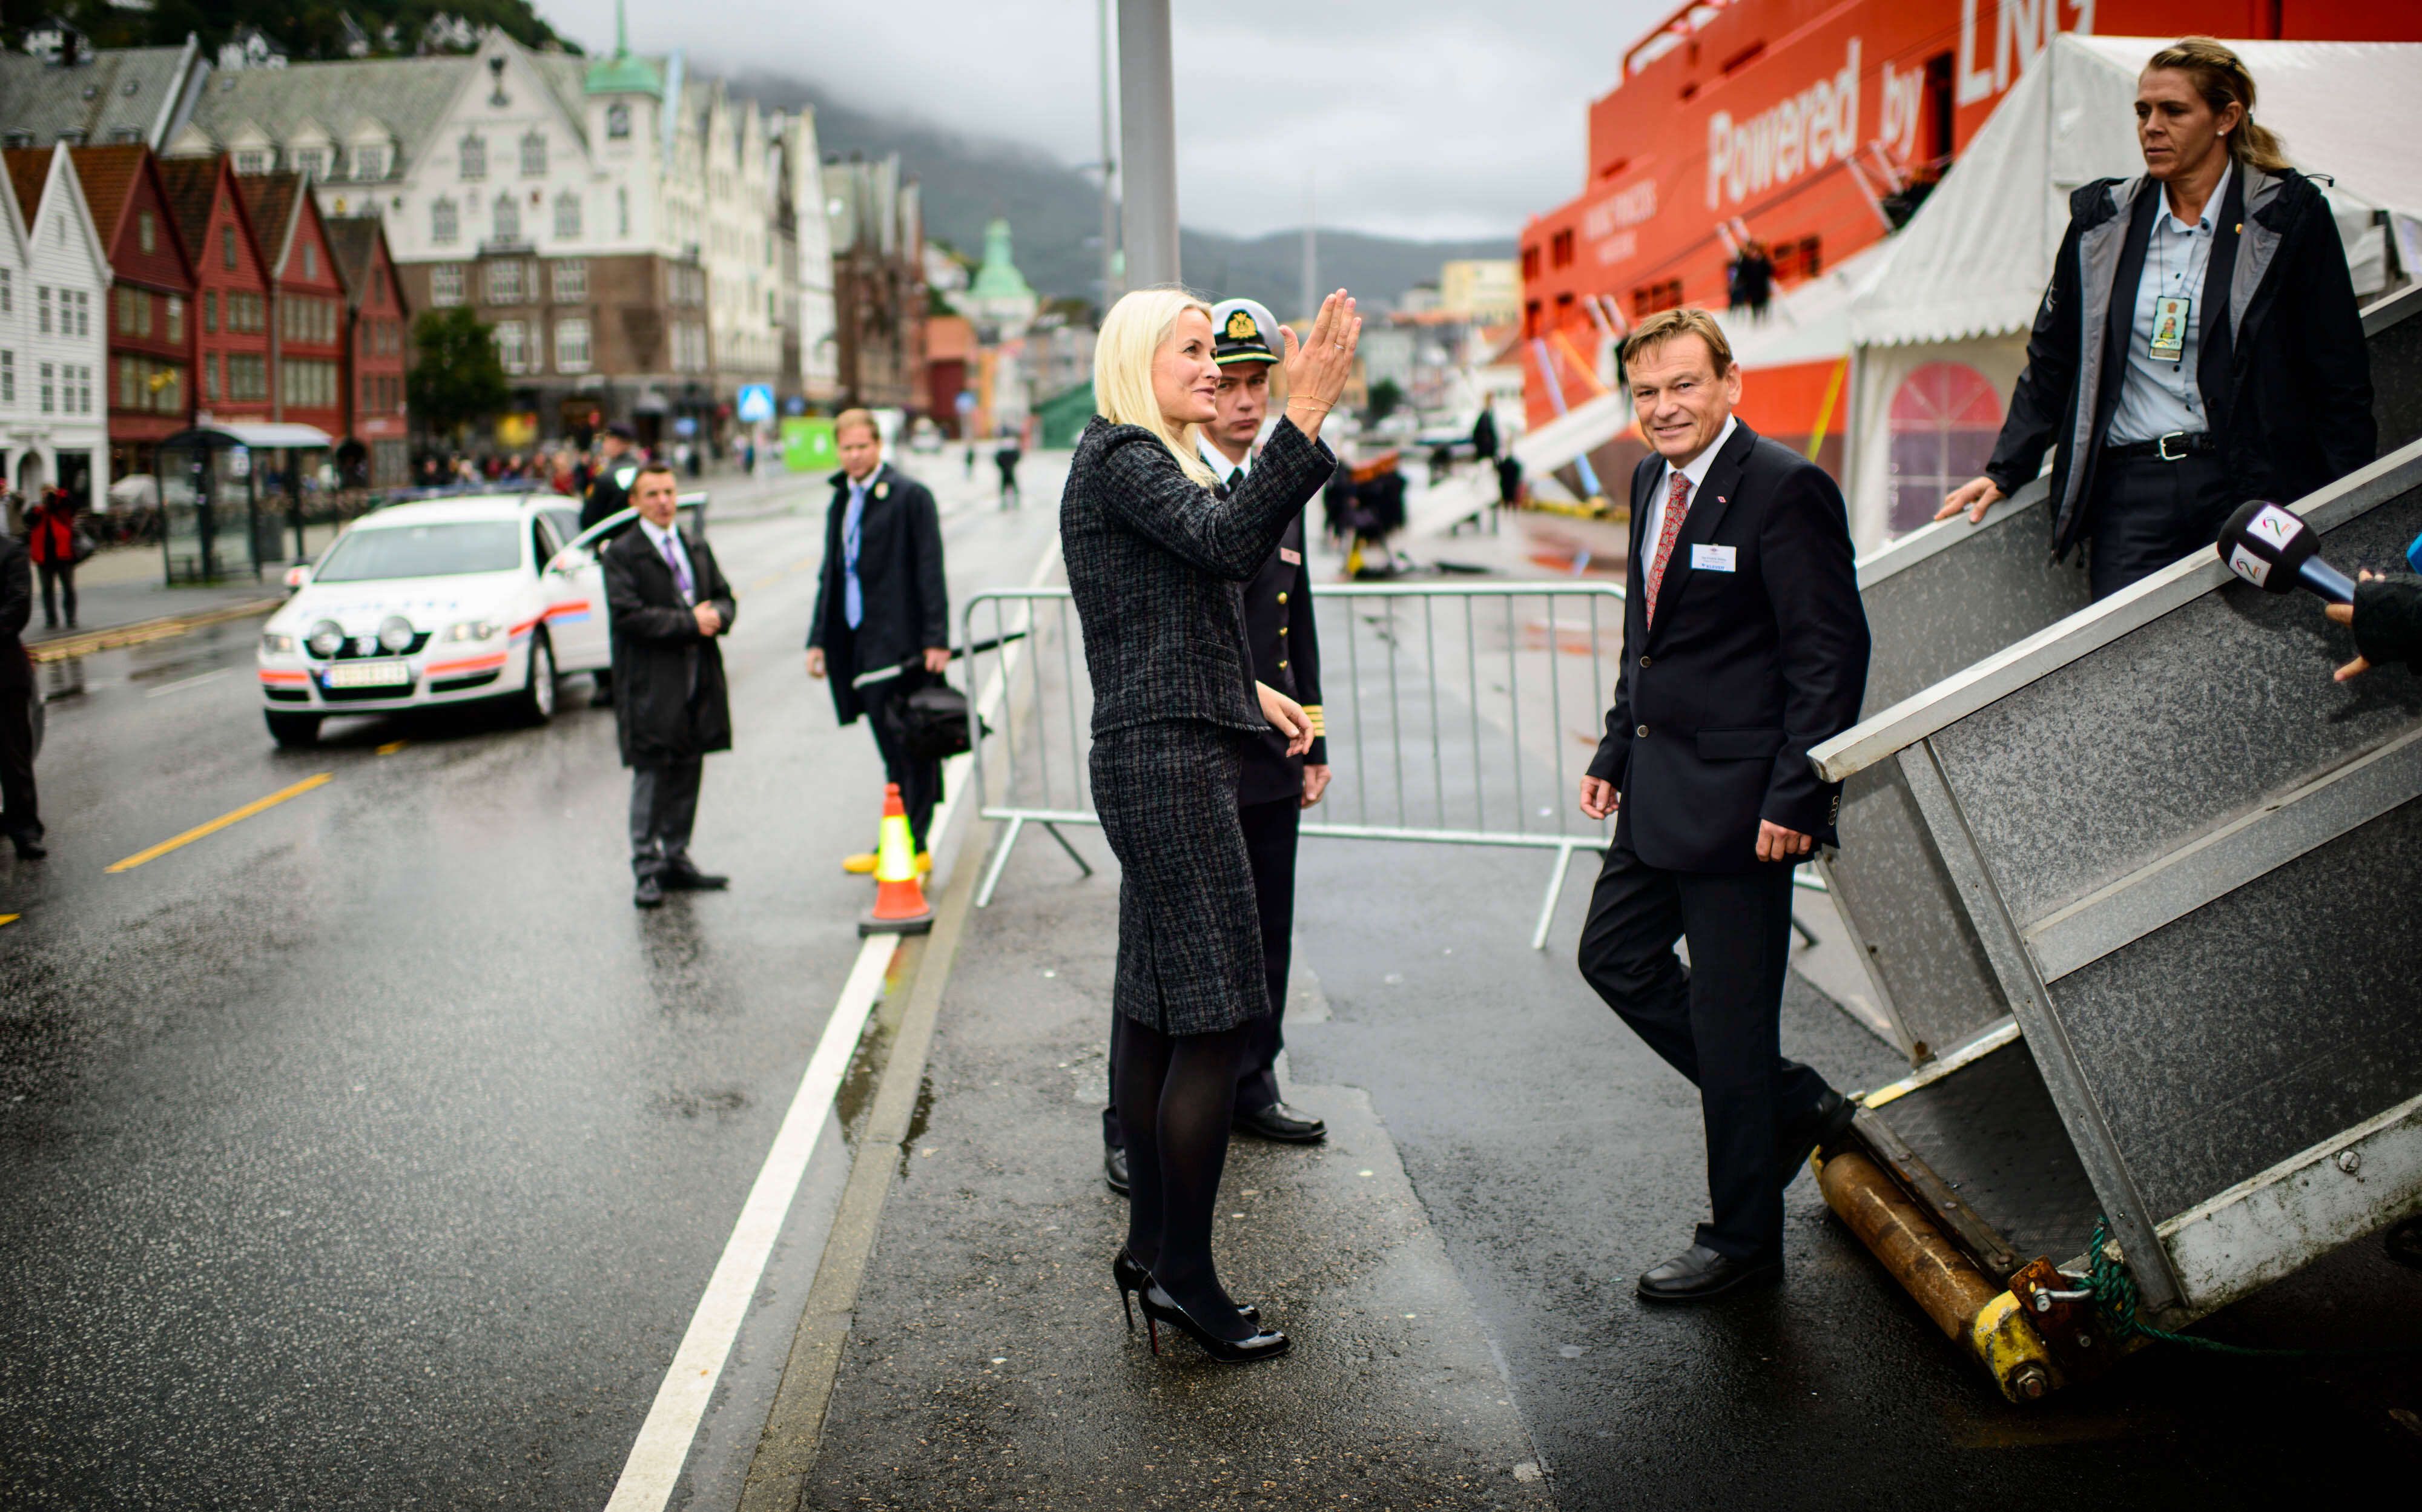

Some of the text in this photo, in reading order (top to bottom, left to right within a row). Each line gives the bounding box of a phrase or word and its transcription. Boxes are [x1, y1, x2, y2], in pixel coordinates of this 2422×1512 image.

[1706, 37, 1862, 211] Powered
[1880, 61, 1925, 161] by
[2263, 516, 2291, 538] 2
[2236, 558, 2262, 579] 2
